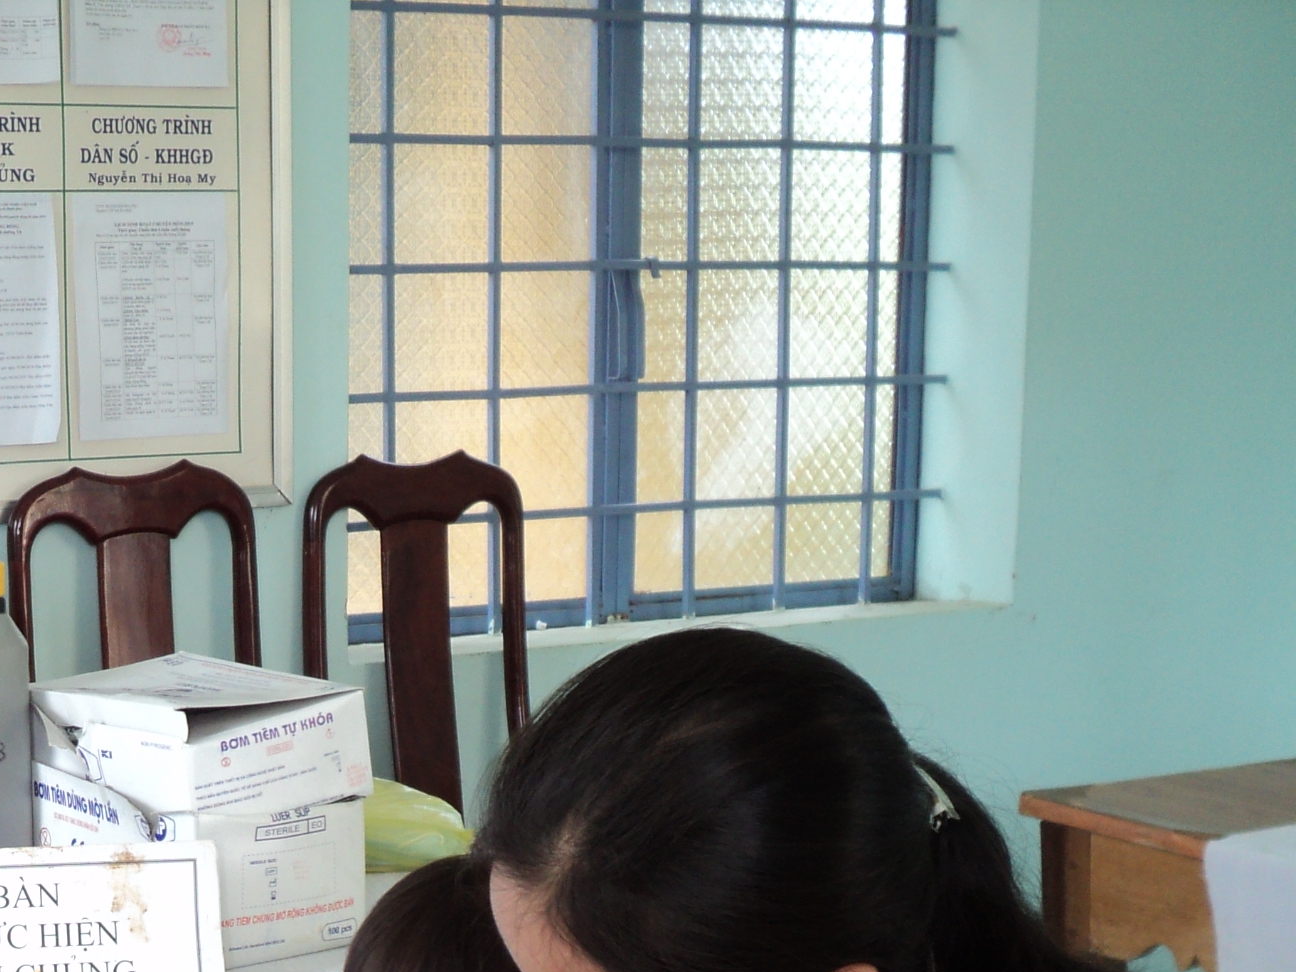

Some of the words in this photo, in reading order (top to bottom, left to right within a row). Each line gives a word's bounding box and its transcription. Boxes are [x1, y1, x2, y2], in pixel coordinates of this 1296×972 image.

[92, 116, 157, 135] CHƯƠNG
[162, 115, 212, 135] TRÌNH
[80, 144, 113, 164] DÂN
[119, 140, 139, 164] SỐ
[155, 148, 214, 165] KHHGĐ
[88, 170, 137, 186] Nguyễn
[142, 173, 162, 185] Thị
[197, 173, 217, 186] My
[220, 736, 250, 753] BƠM
[252, 728, 280, 745] TIÊM
[282, 722, 298, 737] TỰ
[301, 712, 334, 731] KHÓA
[34, 780, 51, 802] BƠM
[51, 784, 67, 807] TIÊM
[67, 789, 88, 814] DÙNG
[88, 798, 104, 824] MỘT
[104, 801, 120, 825] LẦN
[265, 825, 300, 837] STERILE
[311, 820, 323, 830] EO
[38, 917, 119, 952] HIỆN
[328, 925, 340, 935] 100
[341, 925, 353, 935] pcs
